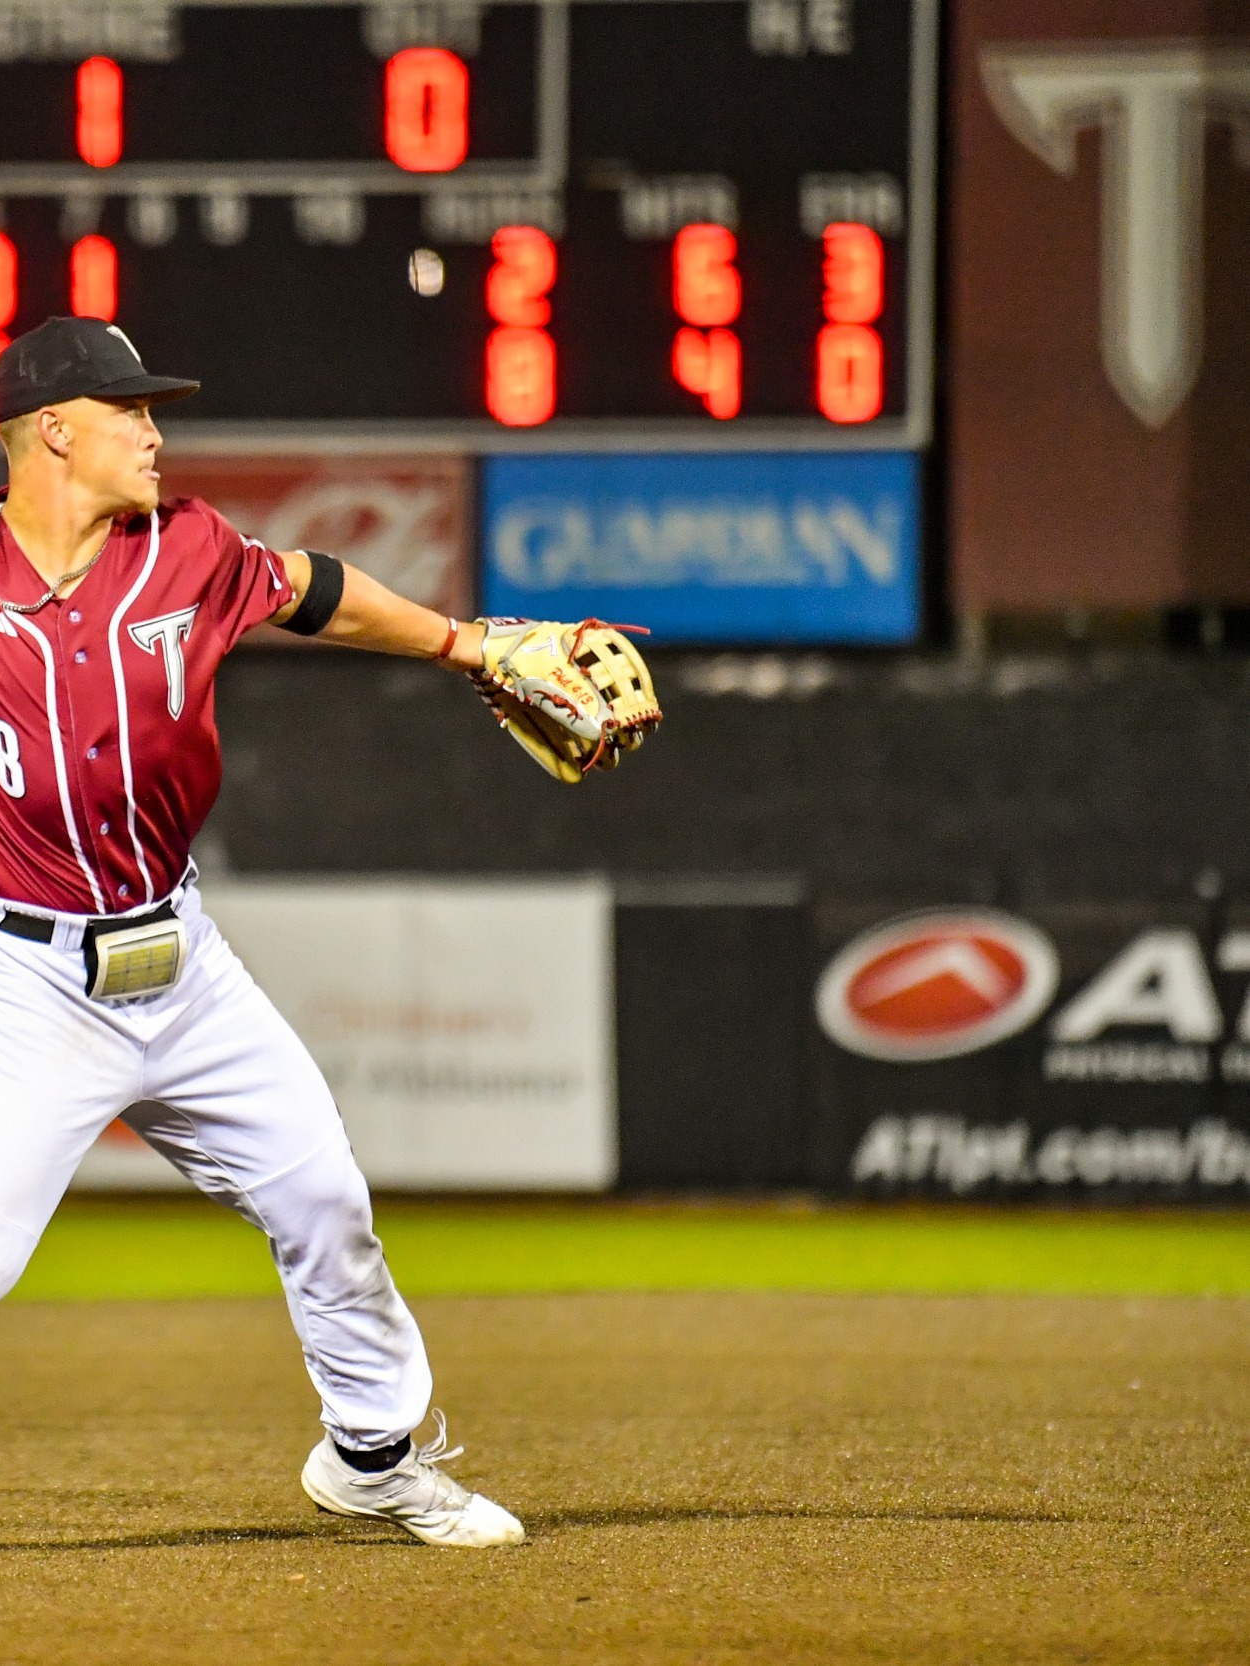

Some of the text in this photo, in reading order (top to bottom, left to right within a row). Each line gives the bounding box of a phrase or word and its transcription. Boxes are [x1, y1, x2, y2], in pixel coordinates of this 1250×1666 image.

[76, 55, 124, 168] 1
[384, 47, 470, 172] 0
[71, 235, 119, 322] 1
[486, 226, 556, 327] 2
[822, 223, 883, 324] 3
[978, 40, 1250, 430] T
[672, 327, 741, 421] 4
[816, 324, 883, 425] 0
[127, 603, 199, 721] T
